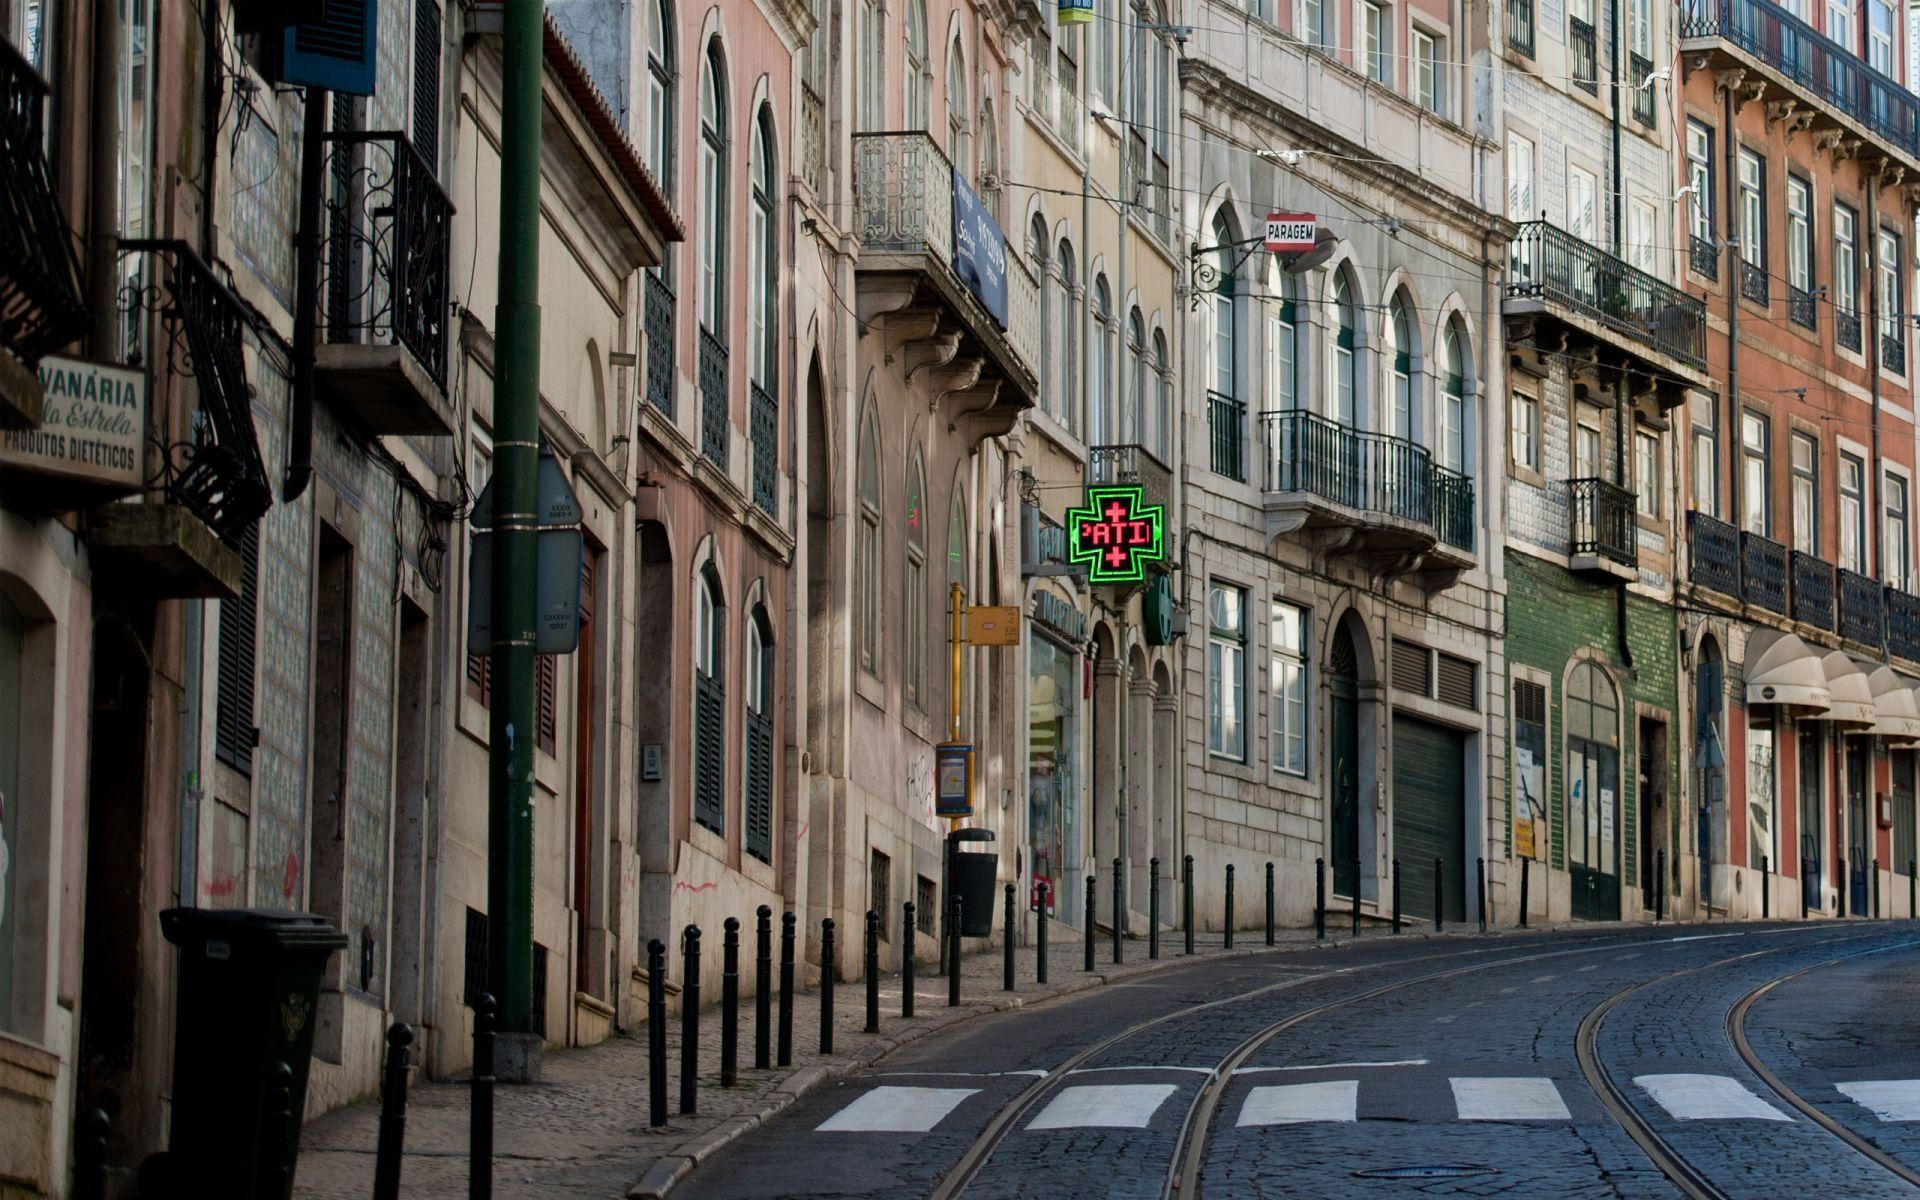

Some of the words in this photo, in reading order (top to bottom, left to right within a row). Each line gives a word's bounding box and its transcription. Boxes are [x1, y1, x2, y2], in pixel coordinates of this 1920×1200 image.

[1268, 224, 1314, 240] PARAGEM
[4, 428, 65, 460] PRODUTOS
[69, 436, 135, 471] DIETÉTICOS
